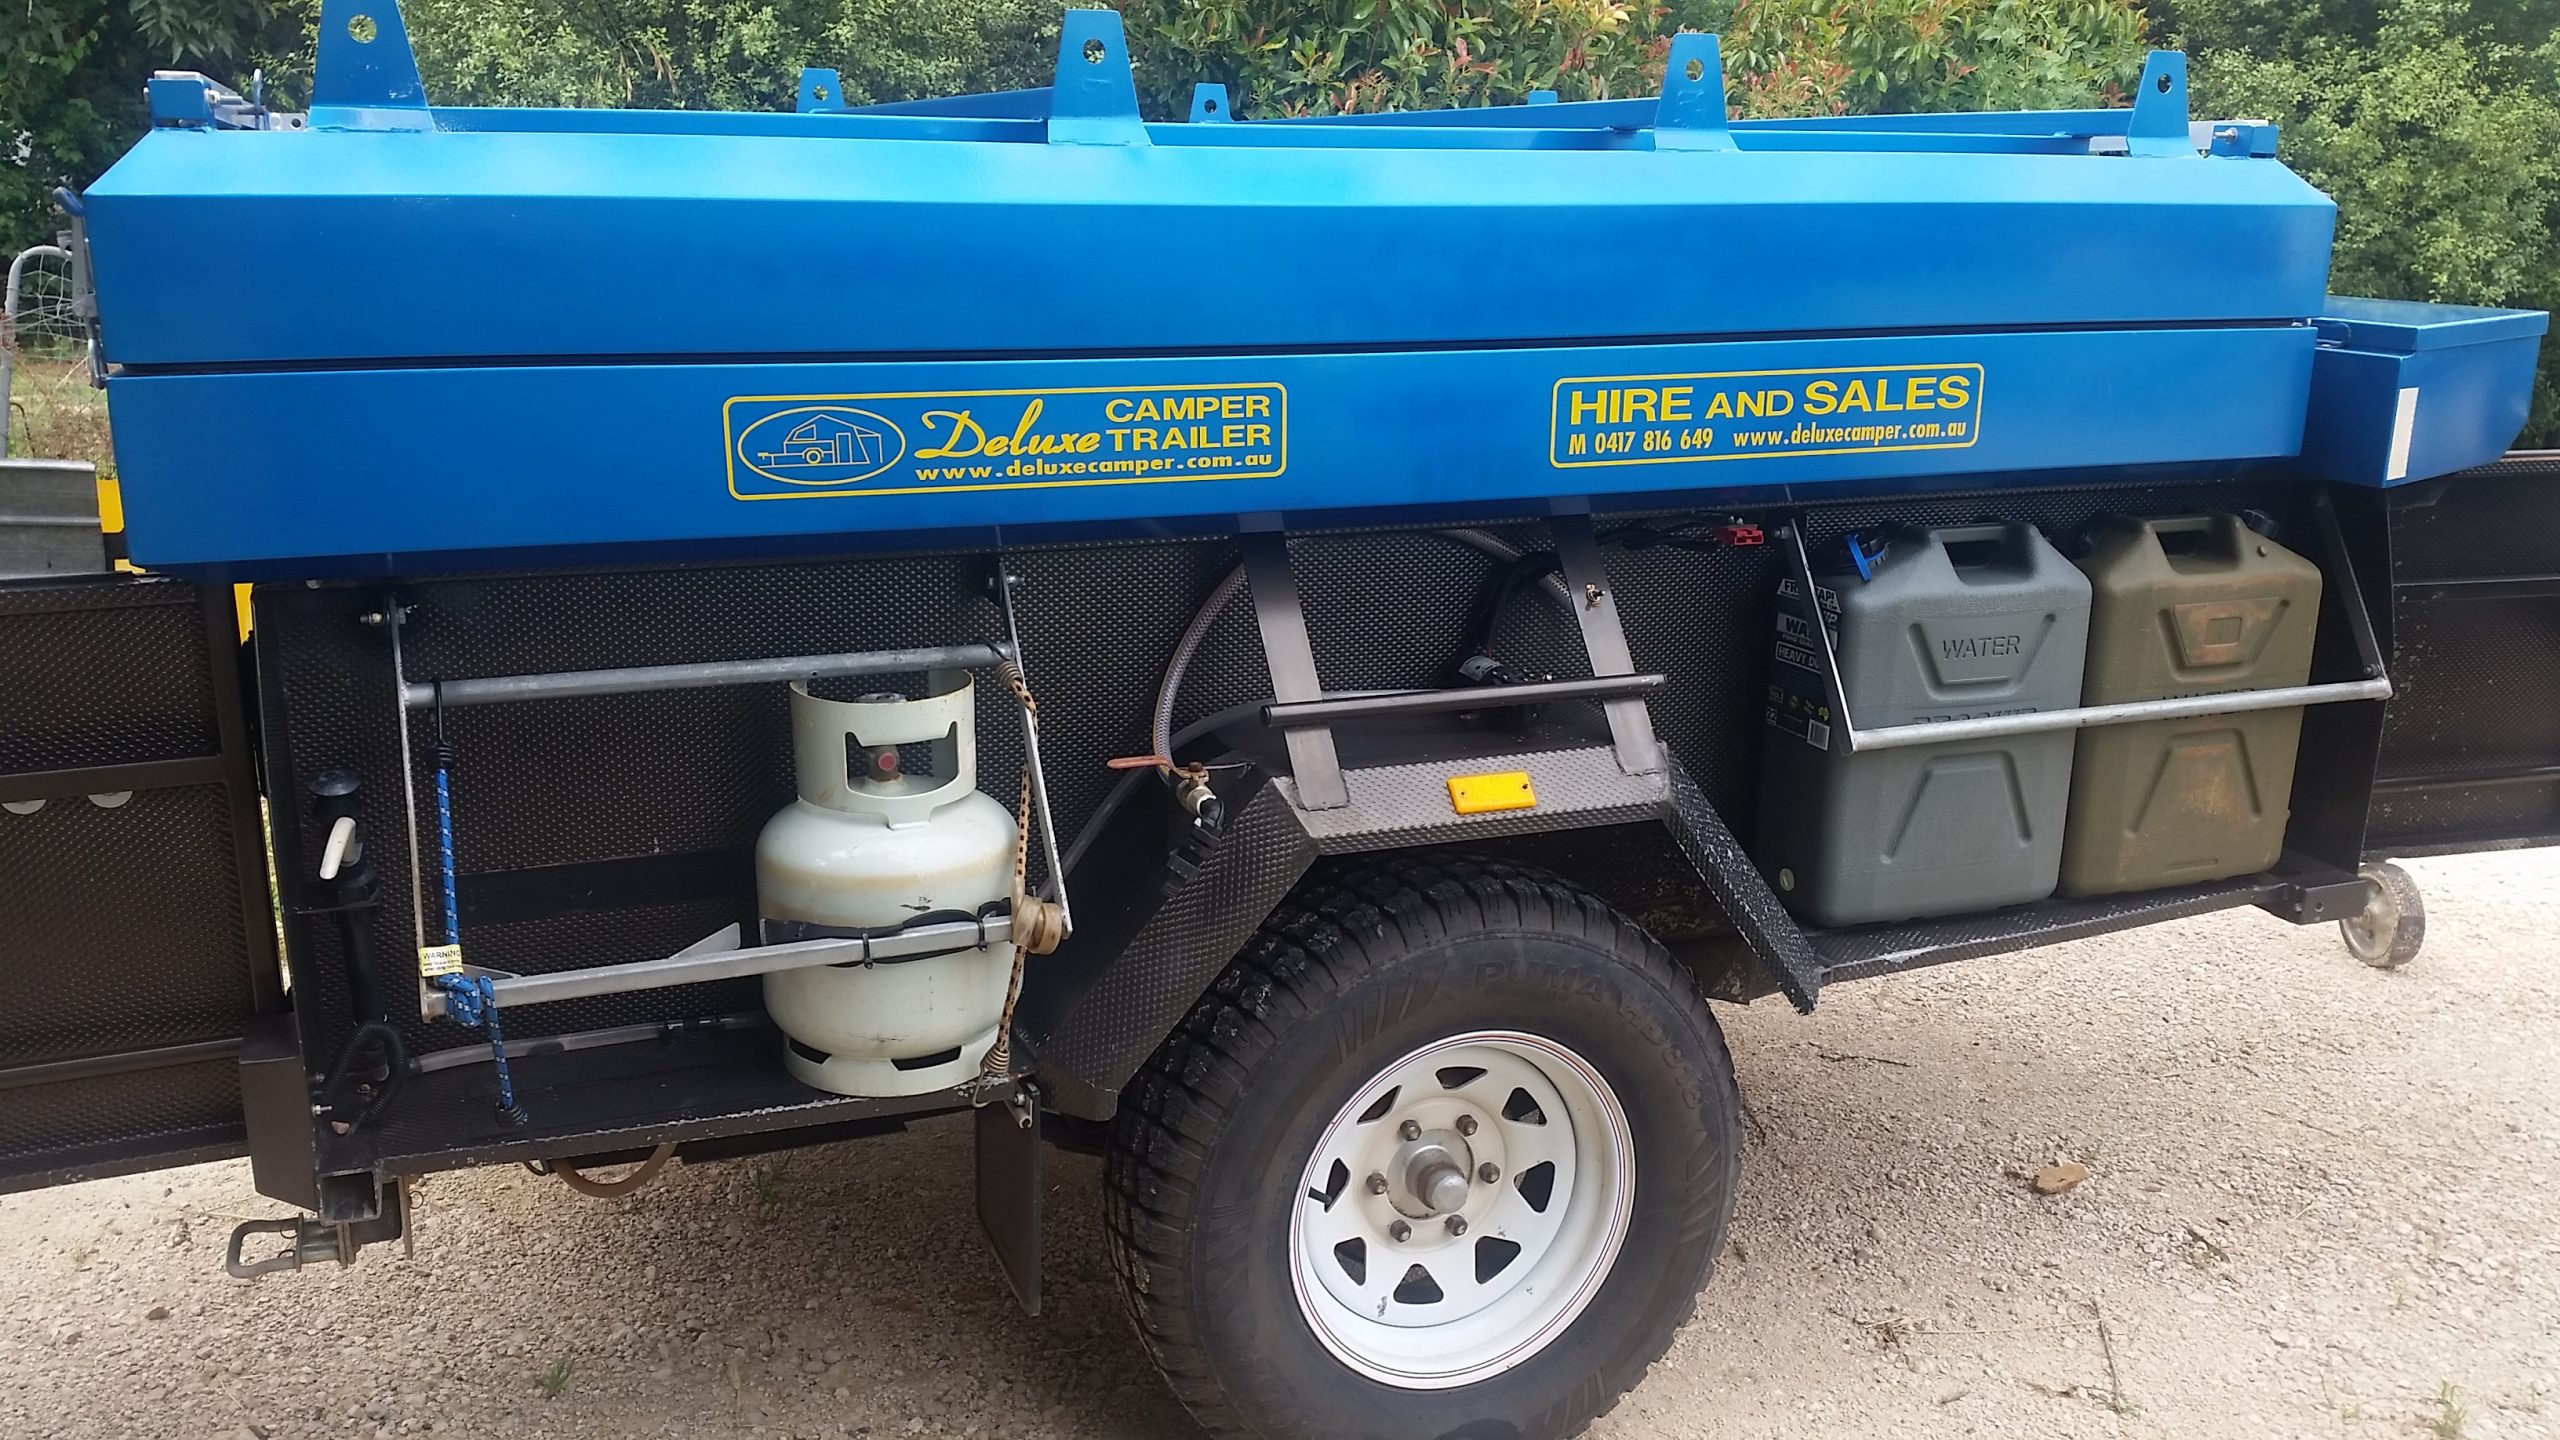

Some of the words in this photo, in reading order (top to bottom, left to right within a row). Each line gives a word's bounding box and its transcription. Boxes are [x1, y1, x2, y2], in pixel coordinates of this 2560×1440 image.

[1105, 395, 1271, 423] CAMPER
[1570, 386, 1694, 425] HIRE
[1704, 389, 1795, 419] AND
[1803, 375, 1970, 415] SALES
[914, 398, 1101, 459] Deluxe
[1106, 424, 1271, 452] TRAILER
[1568, 433, 1586, 455] M
[1594, 431, 1636, 454] 0417
[1643, 429, 1672, 452] 816
[1680, 427, 1713, 449] 649
[1733, 421, 1967, 447] www.deluxecamper.com.au
[915, 453, 1272, 481] www.deluxecamper.com.au
[1778, 646, 1808, 664] HEAVY
[1942, 635, 2020, 660] WATER
[1475, 961, 1602, 1001] PUMA
